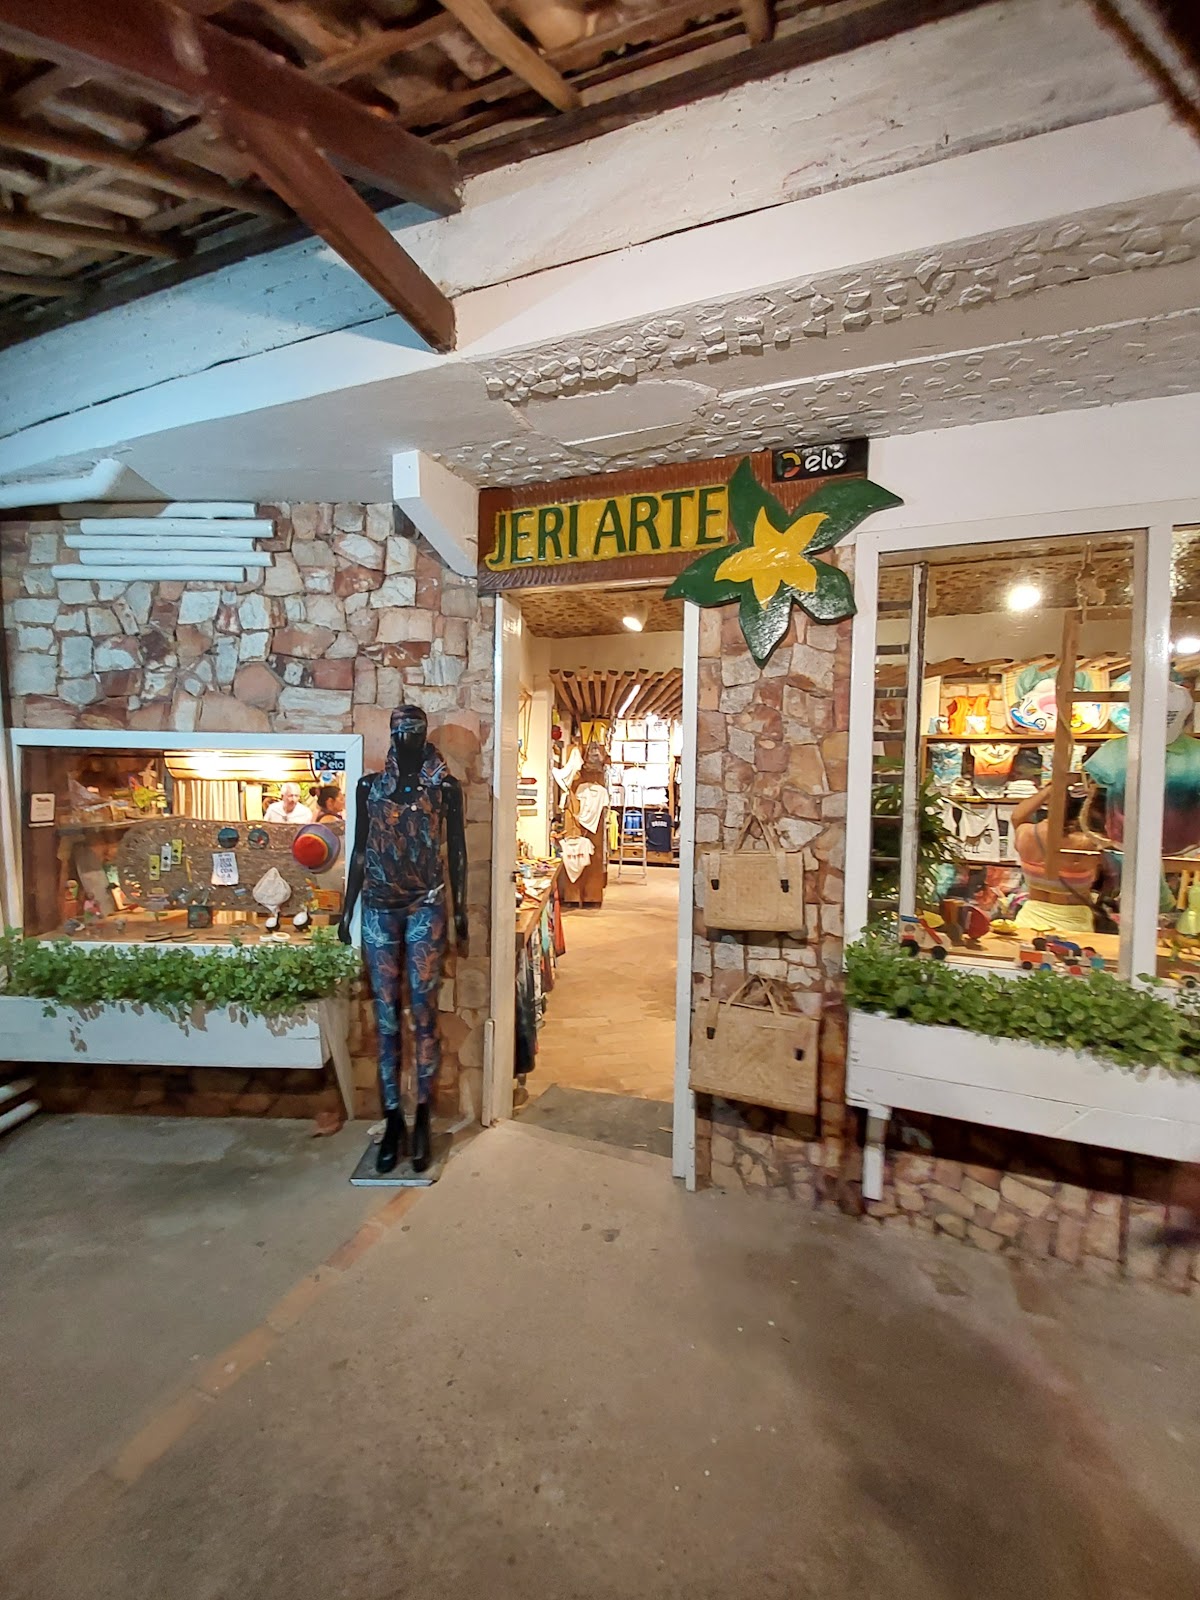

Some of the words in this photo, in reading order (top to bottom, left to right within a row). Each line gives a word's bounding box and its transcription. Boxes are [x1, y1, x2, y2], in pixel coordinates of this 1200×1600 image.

[804, 449, 846, 472] elo
[488, 503, 581, 566] JERI
[593, 485, 727, 555] ARTE
[327, 760, 344, 769] elo
